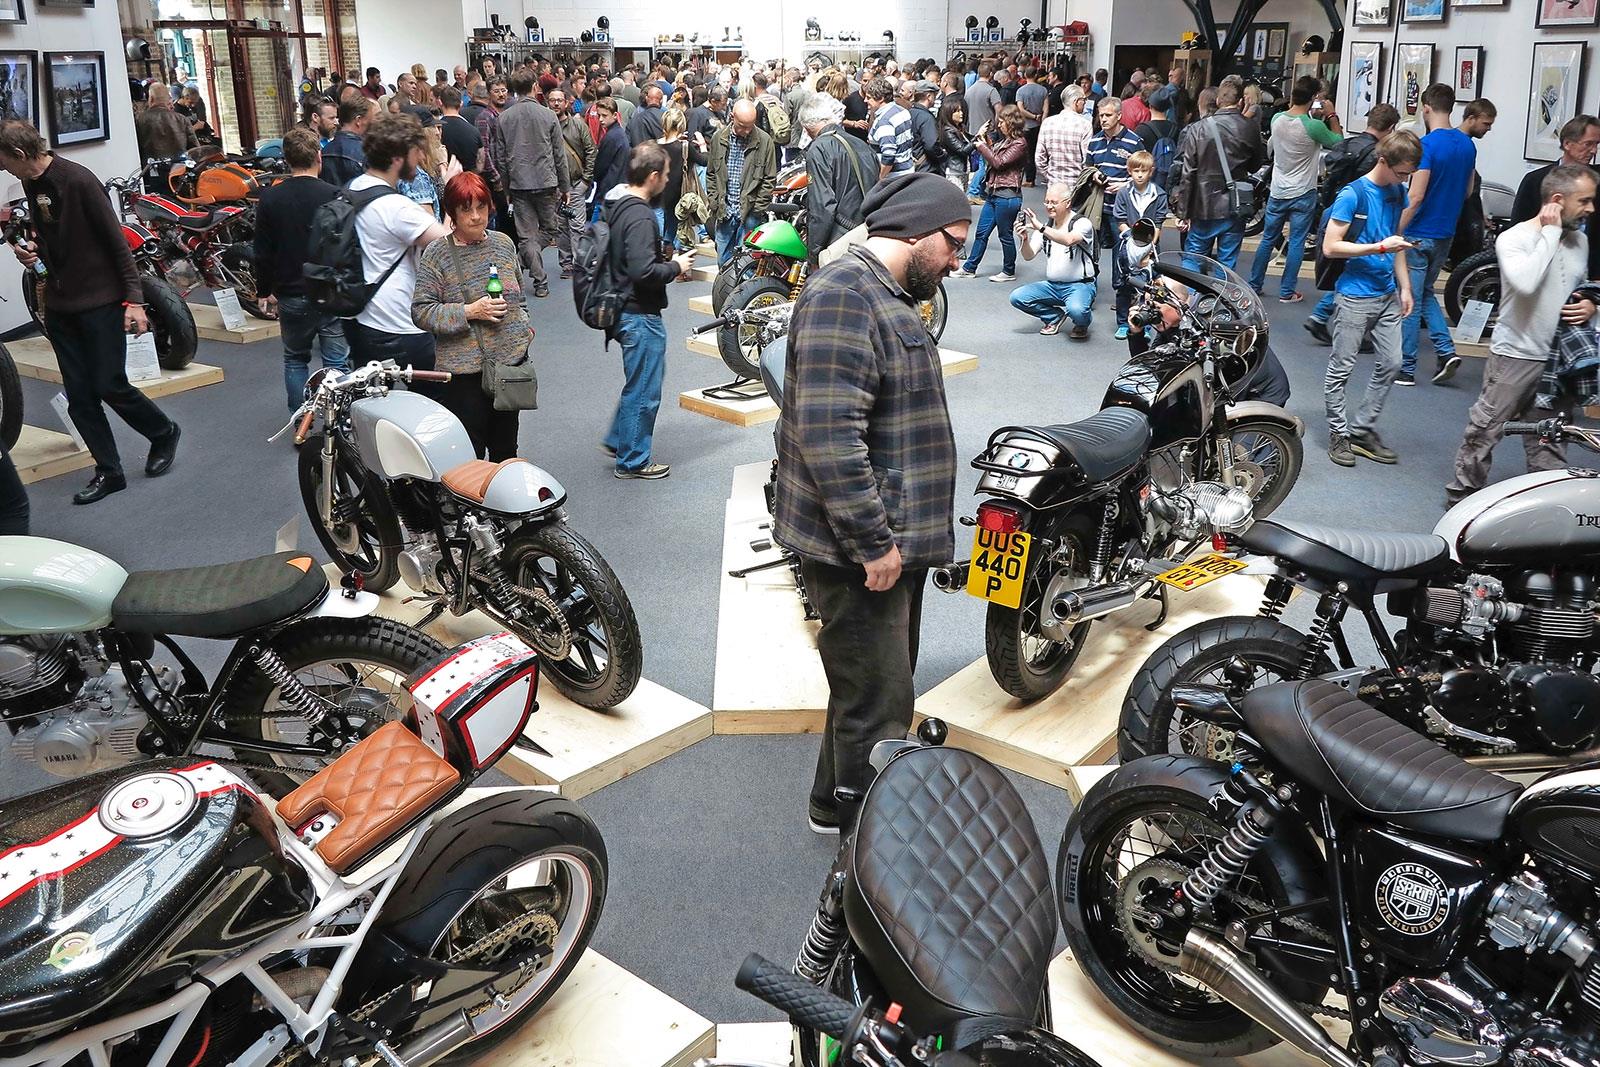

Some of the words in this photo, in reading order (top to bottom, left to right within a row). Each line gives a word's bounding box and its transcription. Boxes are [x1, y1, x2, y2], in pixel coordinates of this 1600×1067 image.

[975, 550, 1021, 580] 440
[985, 576, 1002, 597] P
[44, 753, 78, 763] YAMAHA
[1064, 853, 1079, 904] PIRELLI
